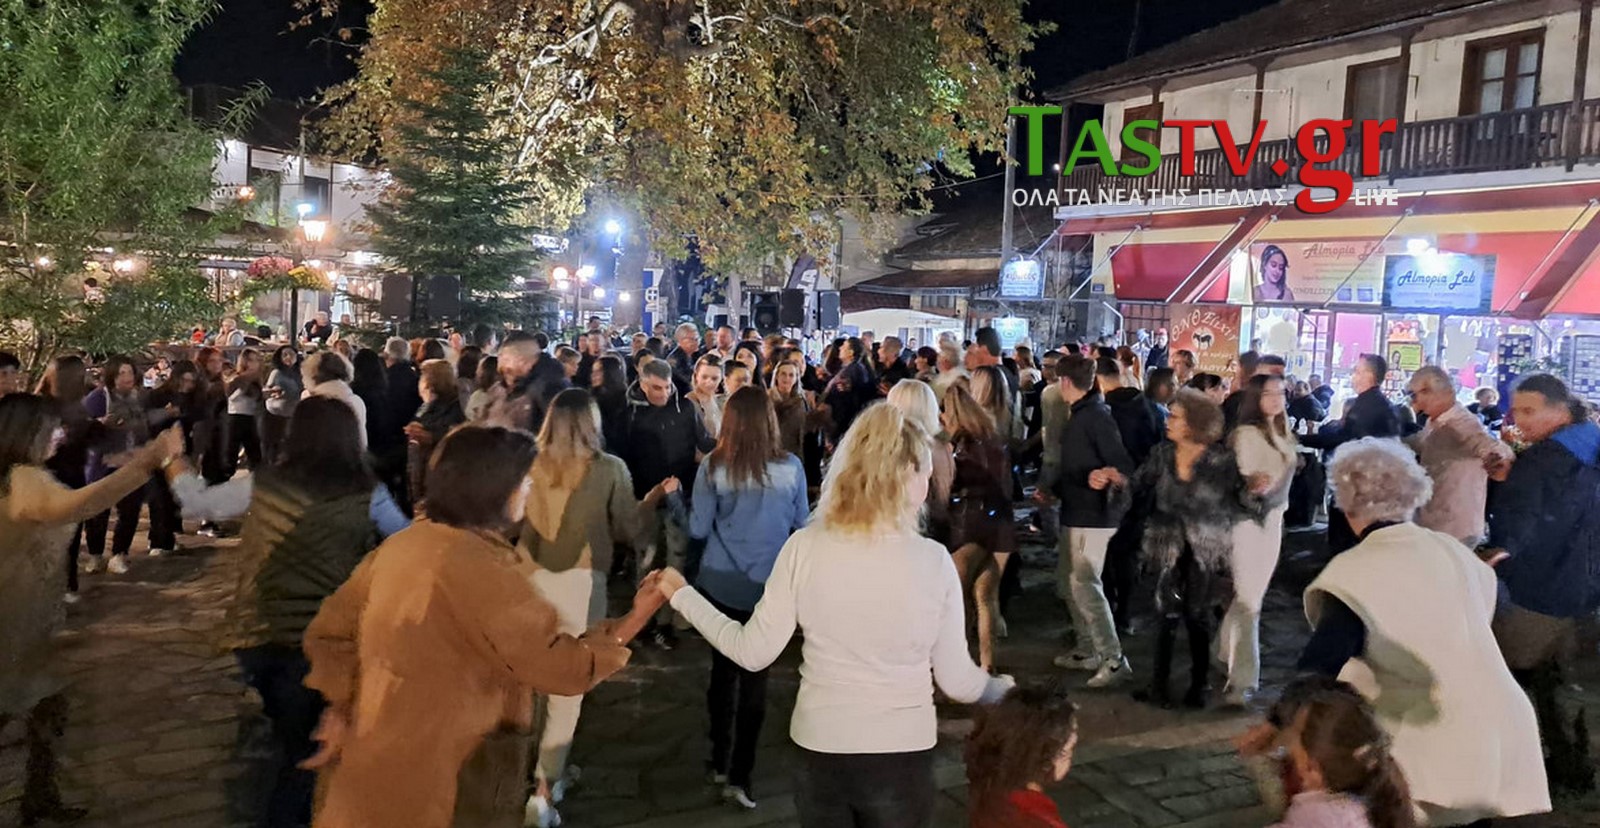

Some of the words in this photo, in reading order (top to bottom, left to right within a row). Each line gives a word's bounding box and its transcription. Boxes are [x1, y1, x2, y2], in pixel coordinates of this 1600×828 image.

[1302, 243, 1355, 260] Almopia
[1397, 270, 1448, 289] Almopia
[1448, 270, 1476, 290] Lab
